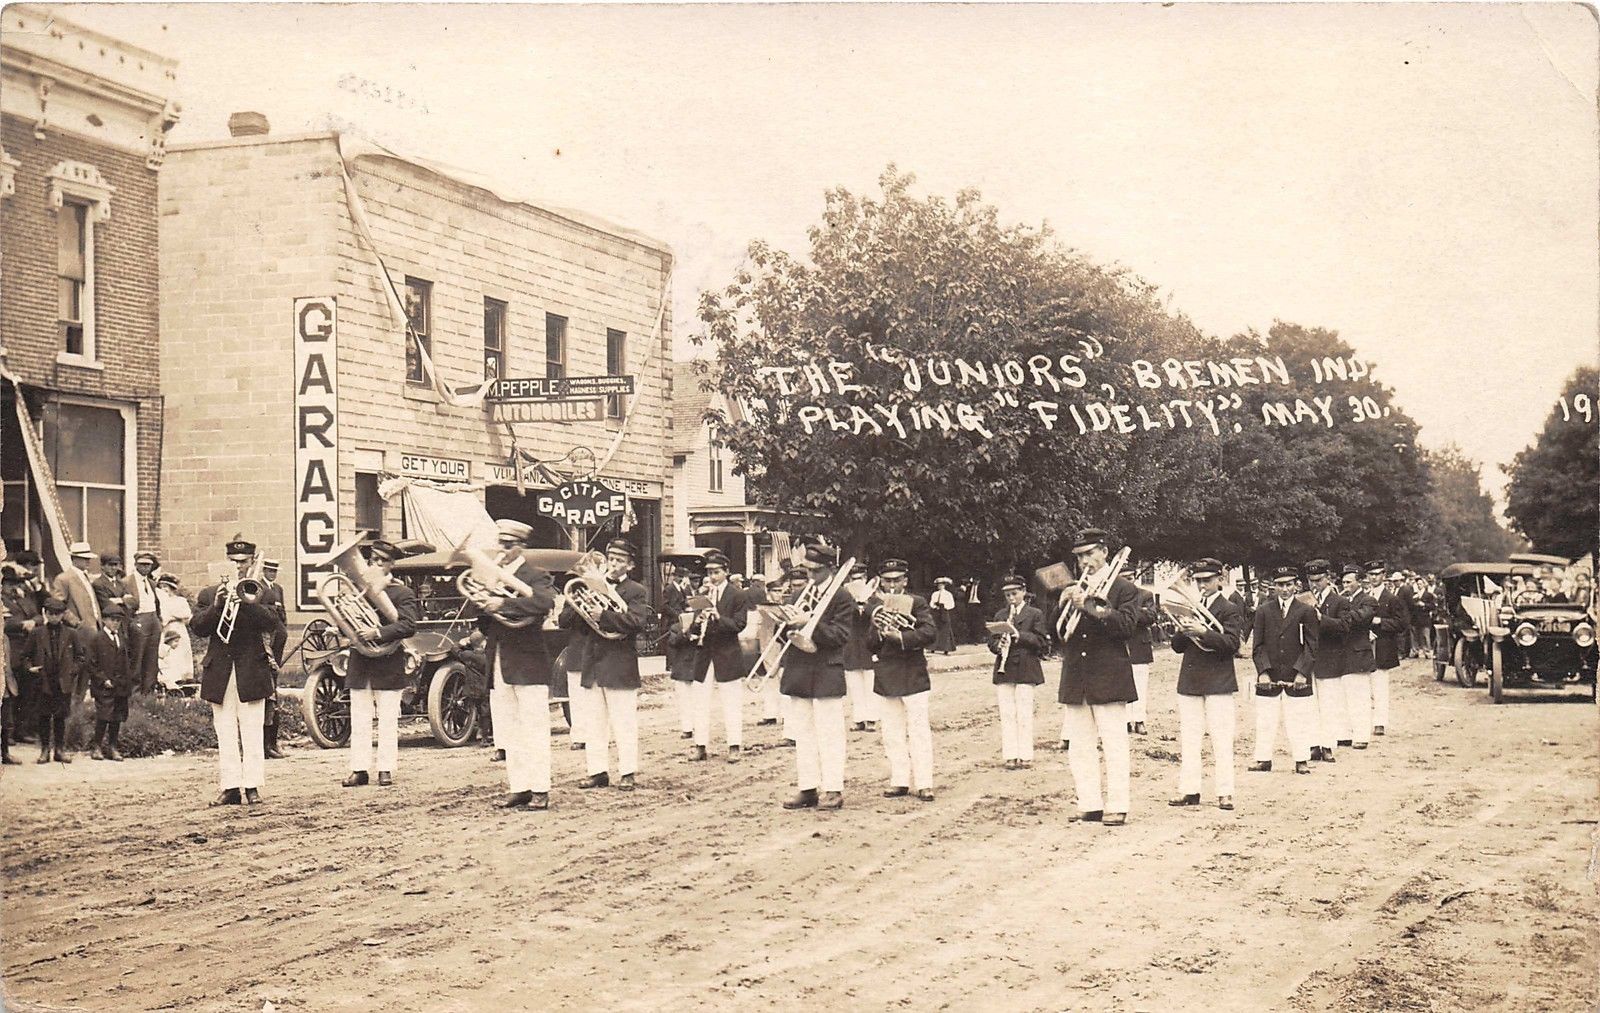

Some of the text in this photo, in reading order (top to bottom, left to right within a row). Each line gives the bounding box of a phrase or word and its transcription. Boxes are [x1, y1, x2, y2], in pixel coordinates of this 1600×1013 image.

[599, 385, 630, 393] SUPPLIES
[493, 401, 597, 422] AUTOMOBILES
[299, 303, 336, 605] GARAGE
[401, 456, 465, 476] GET YOUR
[560, 484, 601, 500] CITY
[597, 478, 621, 491] ONE
[625, 480, 649, 494] HERE
[539, 495, 625, 525] GARAGE
